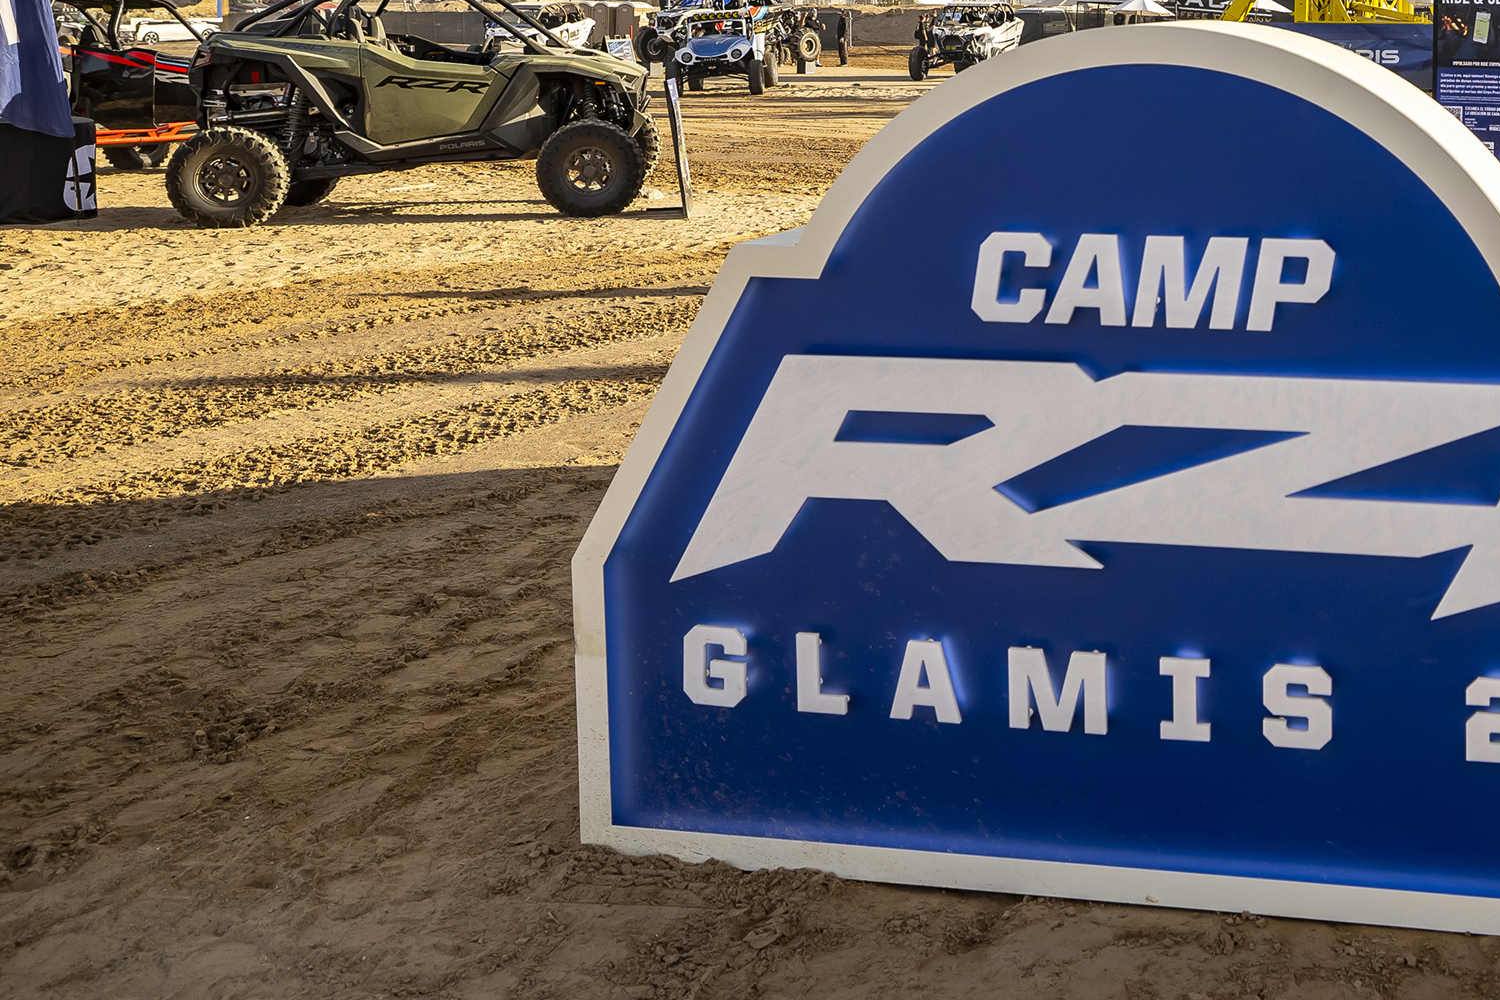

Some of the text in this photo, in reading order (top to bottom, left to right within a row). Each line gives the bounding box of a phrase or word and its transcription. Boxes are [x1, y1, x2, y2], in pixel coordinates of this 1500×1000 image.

[1178, 11, 1208, 20] FFEE
[374, 75, 491, 94] RZR
[439, 140, 486, 150] POLARIS
[971, 231, 1336, 332] CAMP
[682, 624, 1334, 750] GLAMIS
